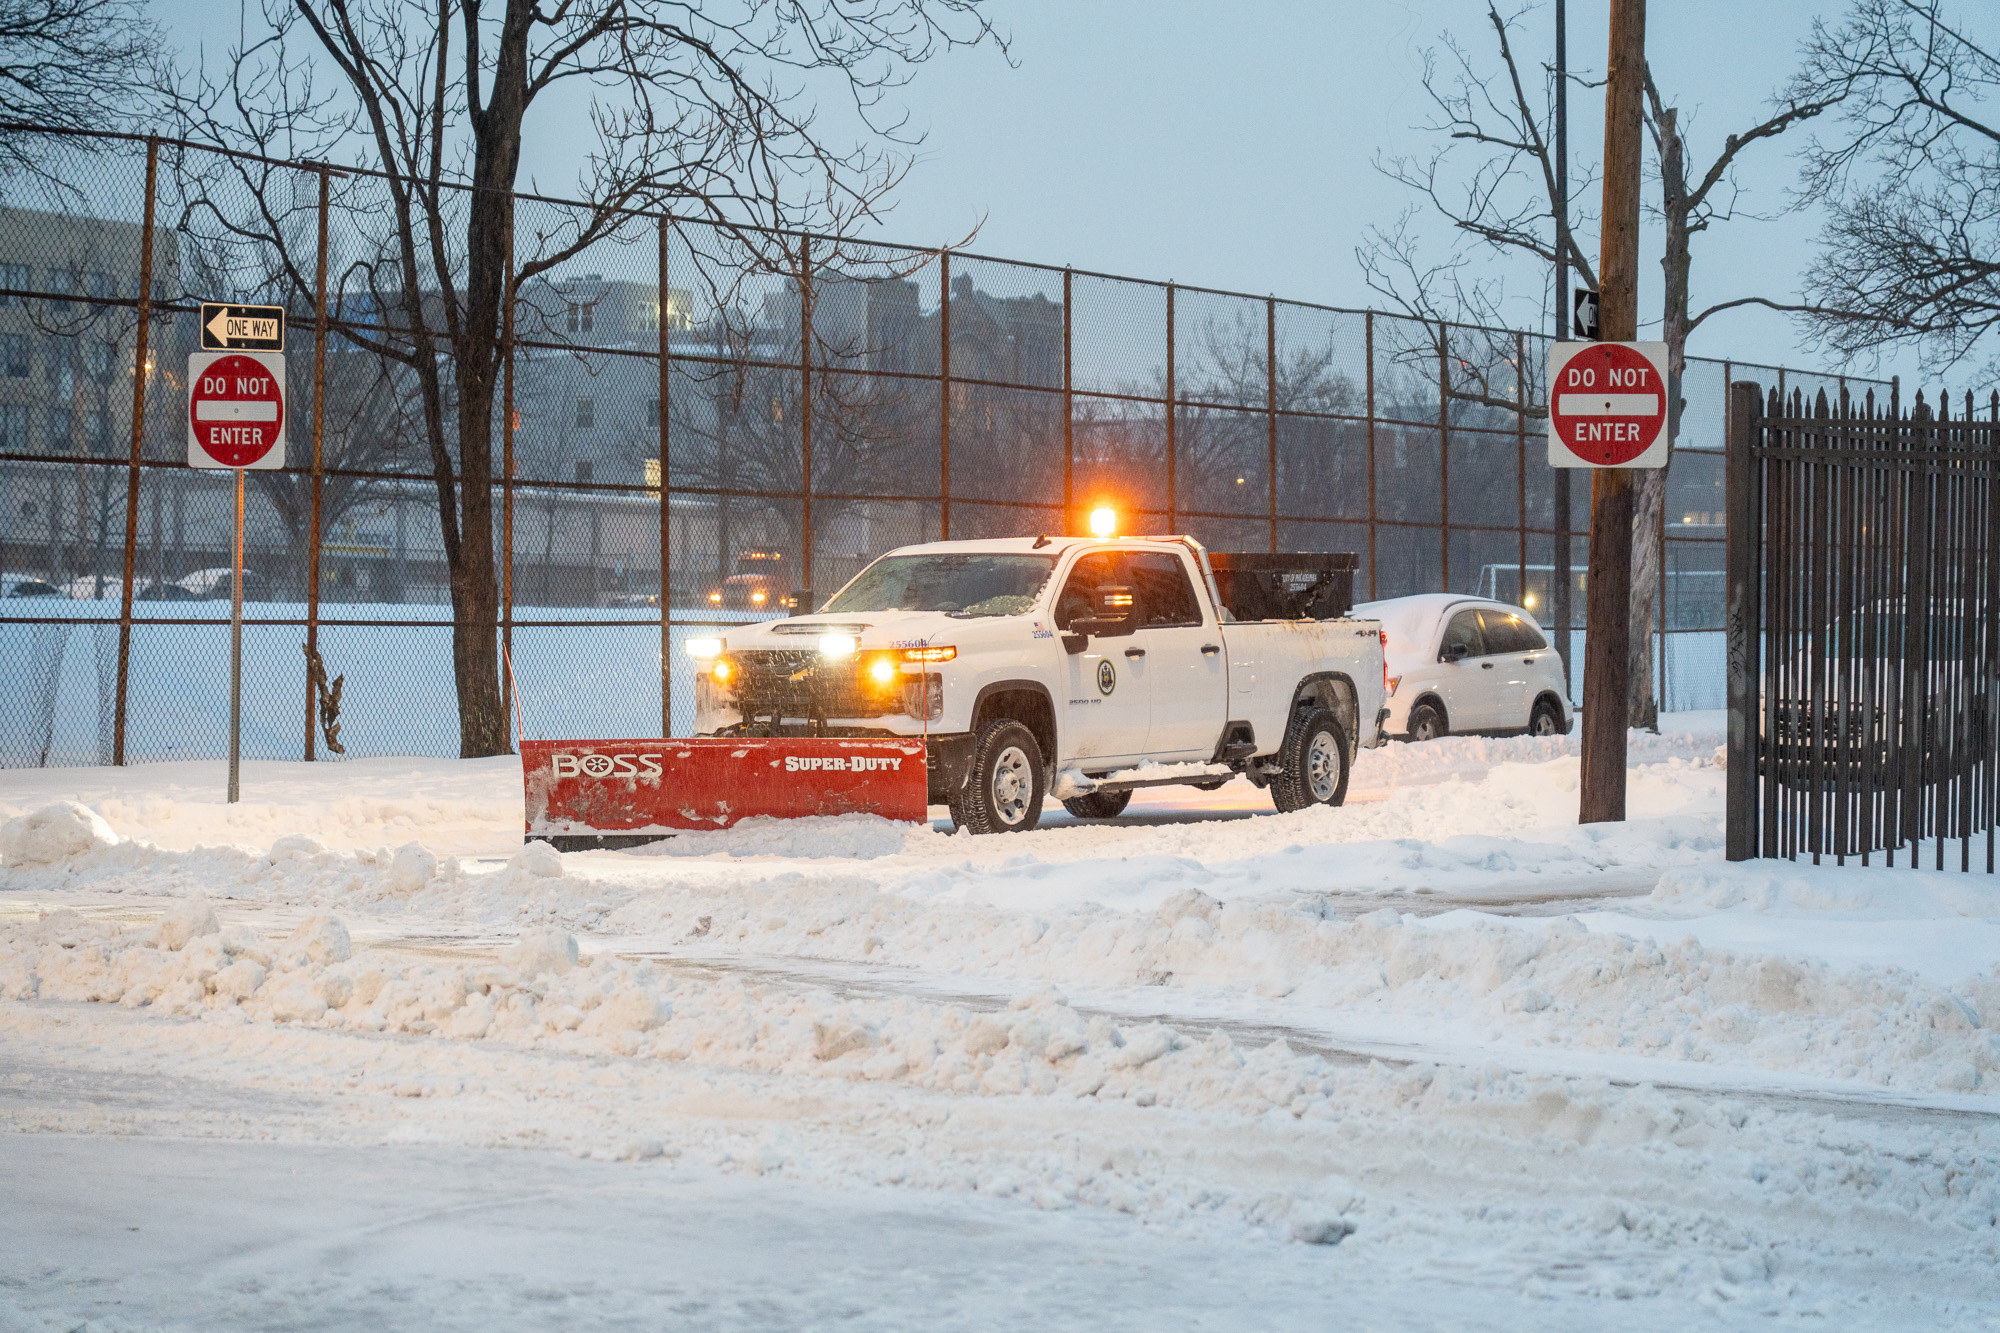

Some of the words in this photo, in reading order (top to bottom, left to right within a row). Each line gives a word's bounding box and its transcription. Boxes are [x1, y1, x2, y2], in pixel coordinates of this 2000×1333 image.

[227, 319, 249, 336] ONE
[252, 320, 275, 337] WAY
[204, 377, 226, 394] DO
[237, 377, 269, 395] NOT
[1568, 368, 1596, 387] DO
[1609, 368, 1648, 387] NOT
[210, 427, 263, 445] ENTER
[1575, 423, 1640, 441] ENTER
[889, 639, 928, 649] 255604
[551, 753, 663, 778] BOSS
[785, 756, 902, 772] SUPER-DUTY
